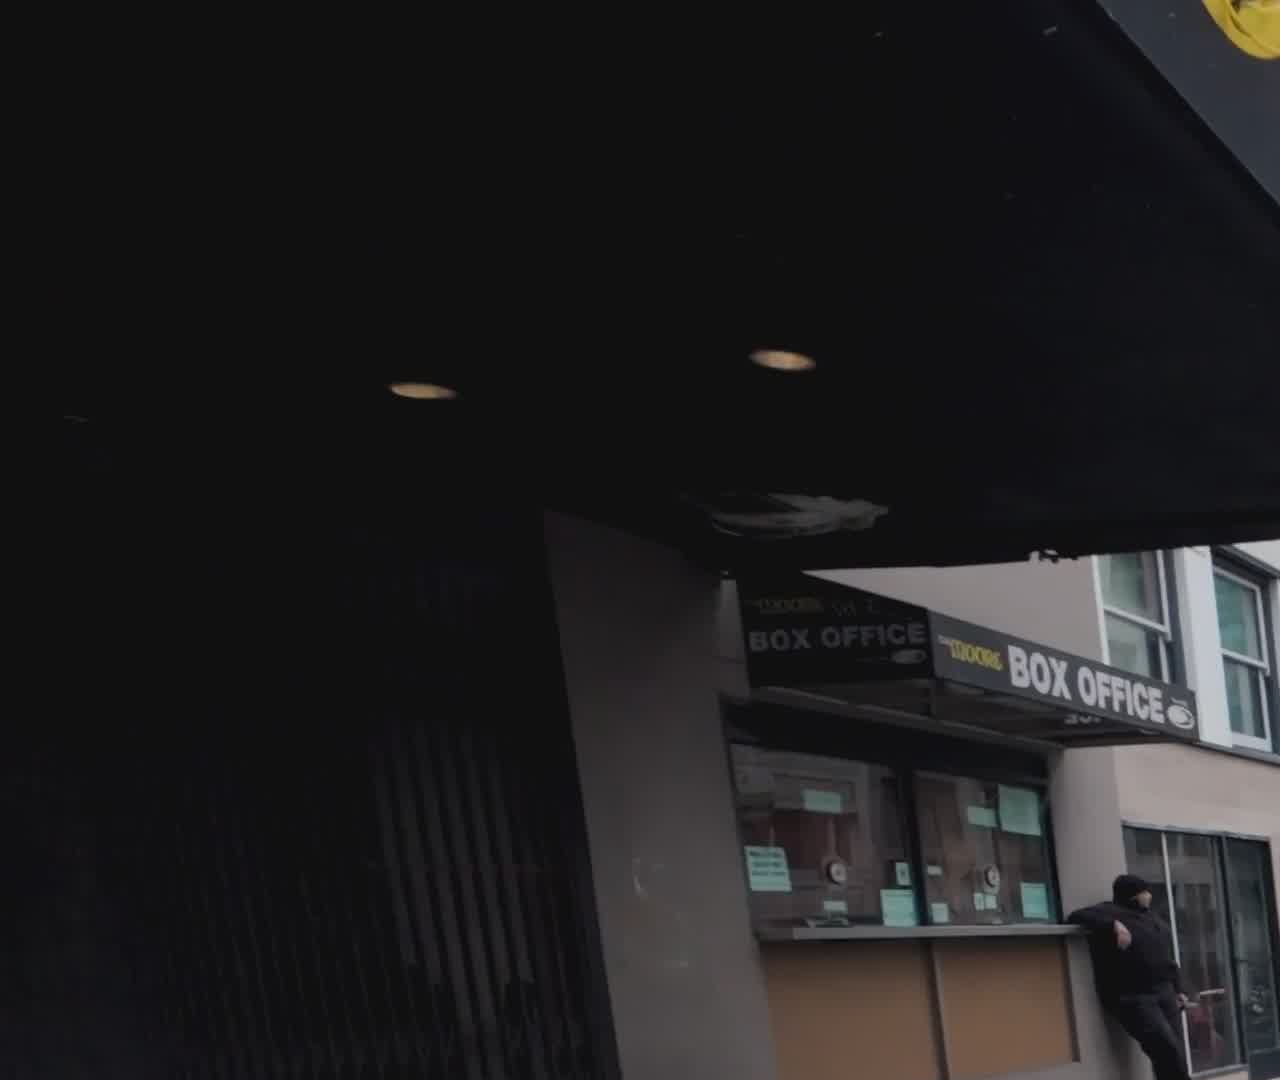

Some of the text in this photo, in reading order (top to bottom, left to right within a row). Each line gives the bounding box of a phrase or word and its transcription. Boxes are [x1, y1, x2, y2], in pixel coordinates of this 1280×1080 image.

[748, 627, 811, 652] BOX
[820, 621, 927, 651] OFFICE
[1007, 644, 1072, 701] BOX
[1077, 665, 1166, 725] OFFICE
